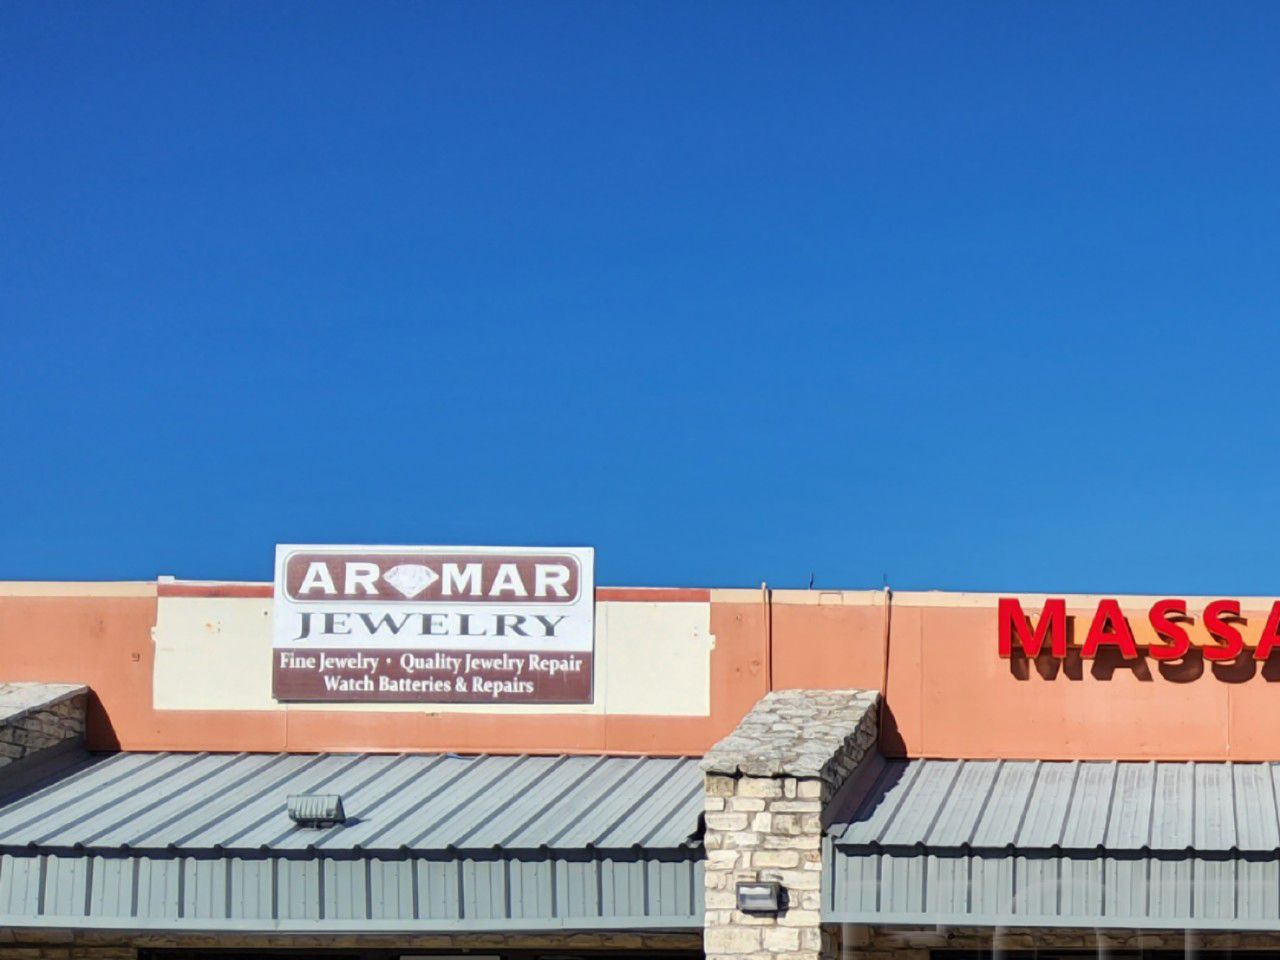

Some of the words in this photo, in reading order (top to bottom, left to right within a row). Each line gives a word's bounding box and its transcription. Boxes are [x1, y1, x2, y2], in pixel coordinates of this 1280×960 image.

[293, 612, 568, 641] JEWELRY
[280, 652, 316, 669] Fine
[318, 652, 380, 674] Jewelry
[400, 653, 461, 675] Quality
[464, 654, 525, 674] Jewelry
[528, 656, 582, 677] Repair
[324, 675, 374, 693] Watch
[379, 675, 454, 694] Batteries
[456, 677, 468, 693] &
[471, 676, 534, 697] Repairs
